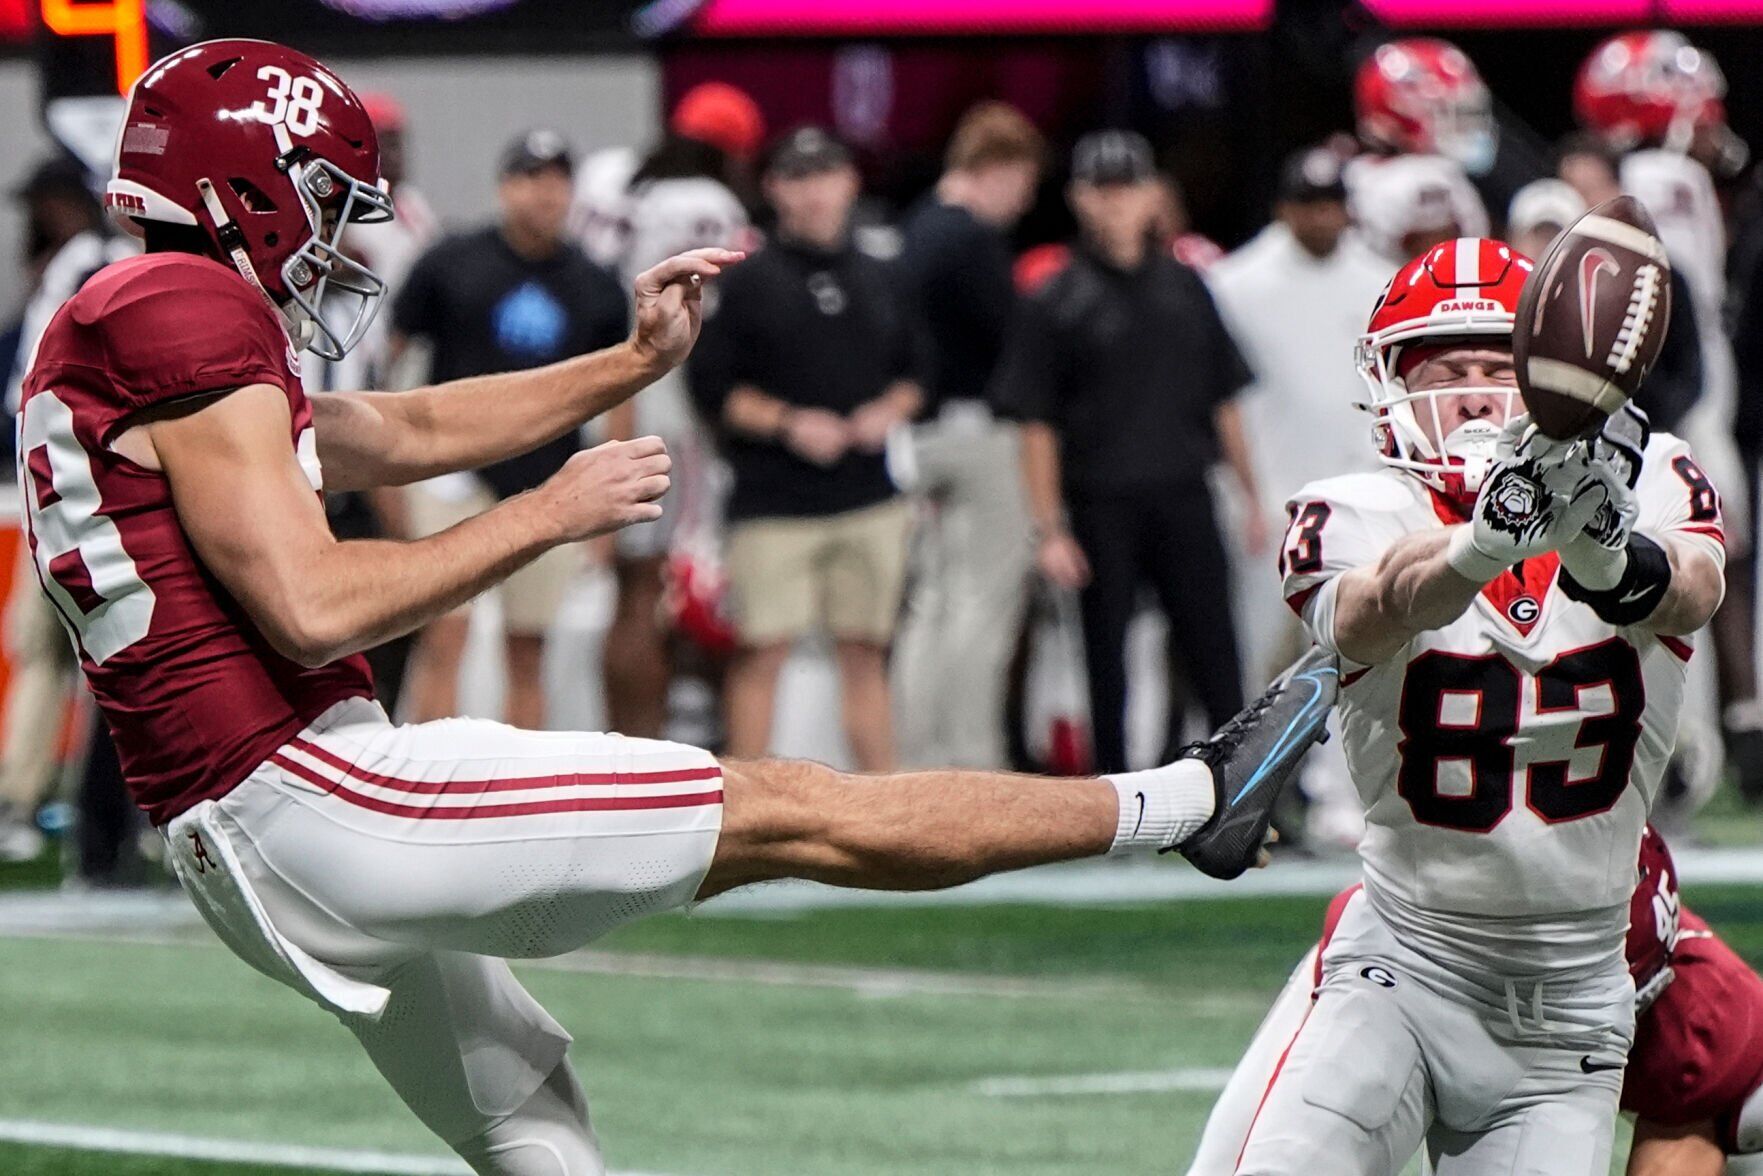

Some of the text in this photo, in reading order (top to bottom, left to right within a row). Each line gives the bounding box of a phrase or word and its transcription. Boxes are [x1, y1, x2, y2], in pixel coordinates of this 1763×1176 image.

[256, 65, 325, 138] 38
[1441, 301, 1495, 312] DAWGS
[16, 389, 157, 667] 8
[1509, 598, 1539, 623] G
[1397, 635, 1646, 834] 83
[1360, 966, 1398, 988] G
